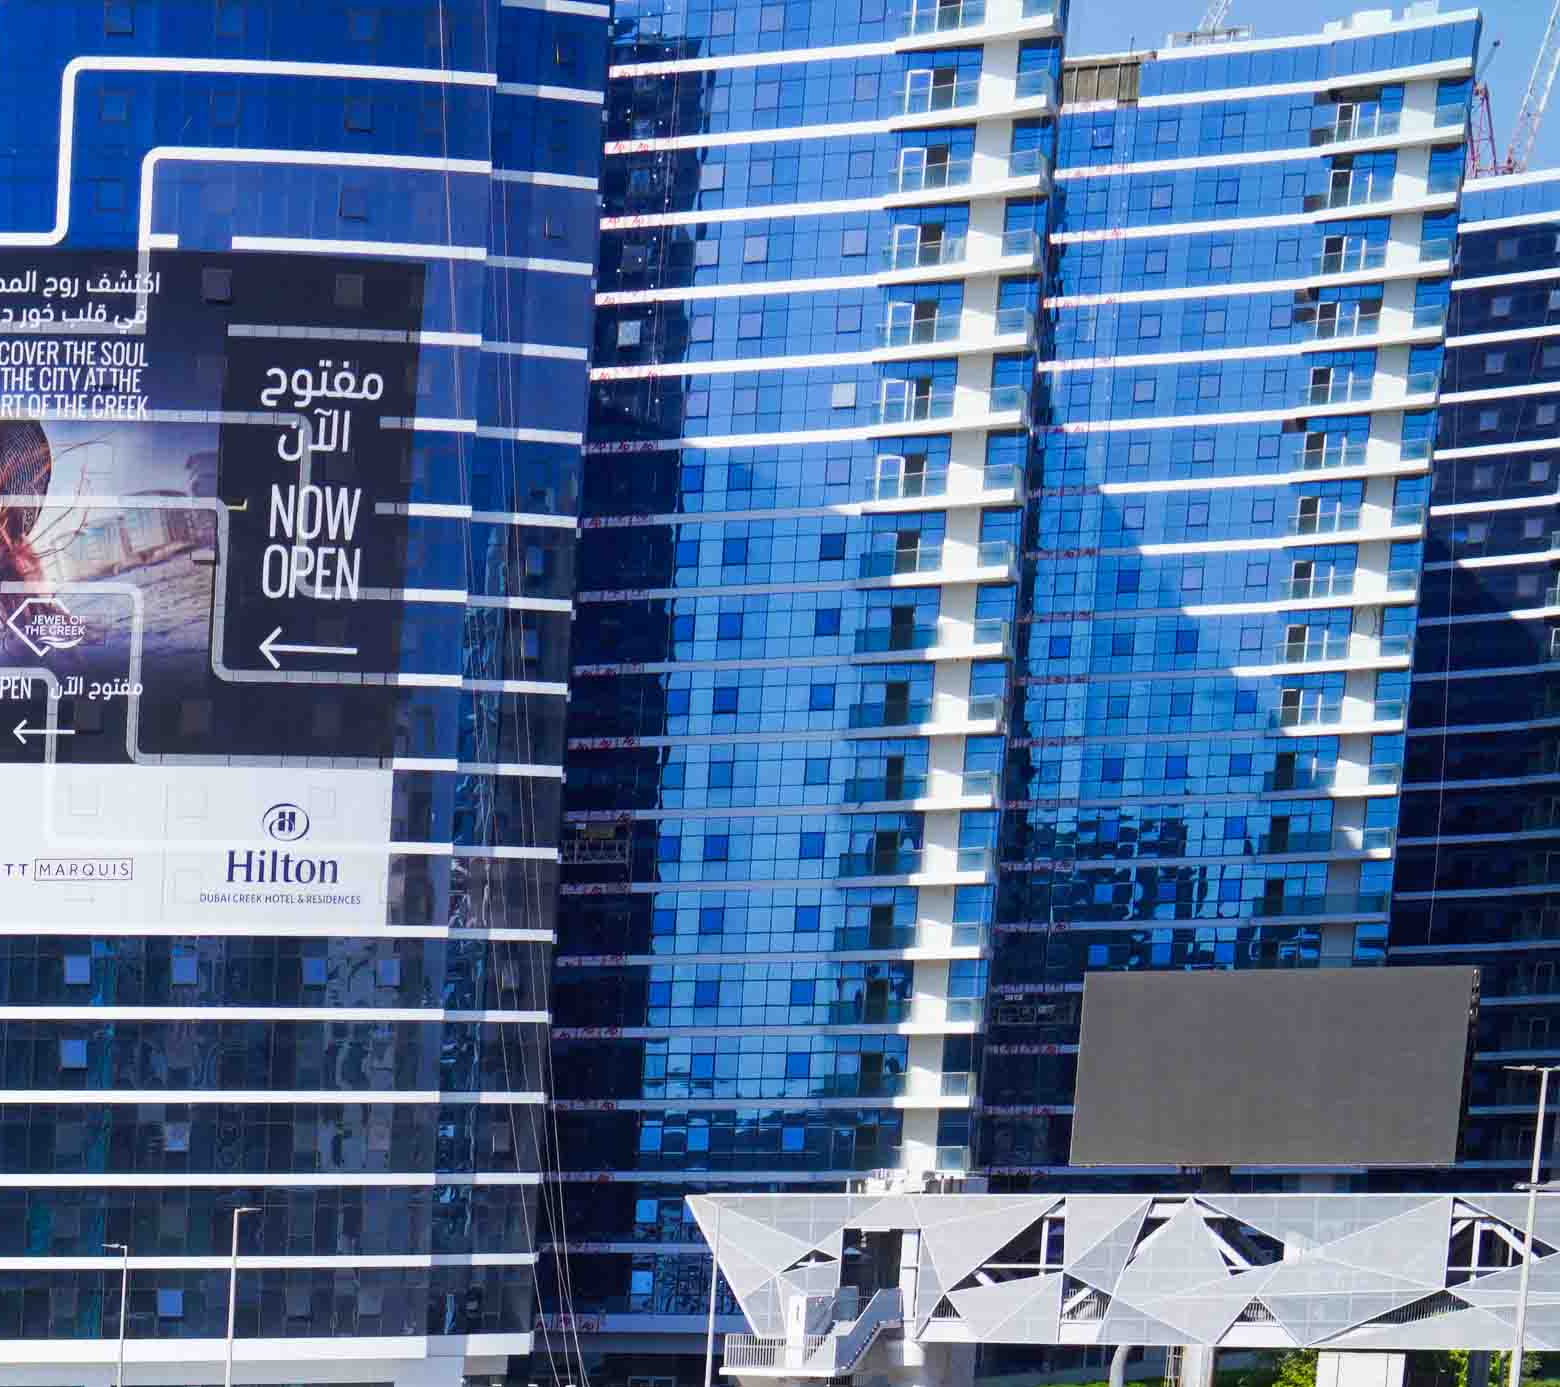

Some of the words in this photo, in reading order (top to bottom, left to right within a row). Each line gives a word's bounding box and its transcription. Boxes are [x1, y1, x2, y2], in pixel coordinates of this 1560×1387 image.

[42, 277, 79, 297] روح
[86, 269, 161, 294] اكتشف
[19, 303, 54, 329] خور
[61, 301, 107, 328] قلب
[113, 303, 148, 334] في
[62, 341, 97, 366] THE
[100, 342, 149, 367] SOUL
[0, 367, 35, 392] THE
[39, 367, 81, 392] CITY
[84, 368, 107, 393] AT
[109, 368, 143, 393] THE
[261, 359, 384, 408] مفتوح
[28, 394, 50, 418] OF
[54, 394, 88, 419] THE
[91, 395, 149, 419] CREEK
[277, 408, 351, 462] الآن
[269, 484, 362, 541] NOW
[262, 544, 361, 601] OPEN
[24, 625, 48, 636] THE
[49, 625, 86, 636] CREEK
[31, 615, 68, 625] JEWEL
[70, 615, 86, 625] OF
[50, 675, 83, 700] الآن
[88, 678, 144, 700] مفتوح
[39, 862, 129, 877] MARQUIS
[226, 850, 339, 884] Hilton
[200, 893, 231, 903] DUBAI
[232, 893, 262, 903] CREEK
[265, 894, 295, 904] HOTEL
[306, 895, 361, 905] RESIDENCES
